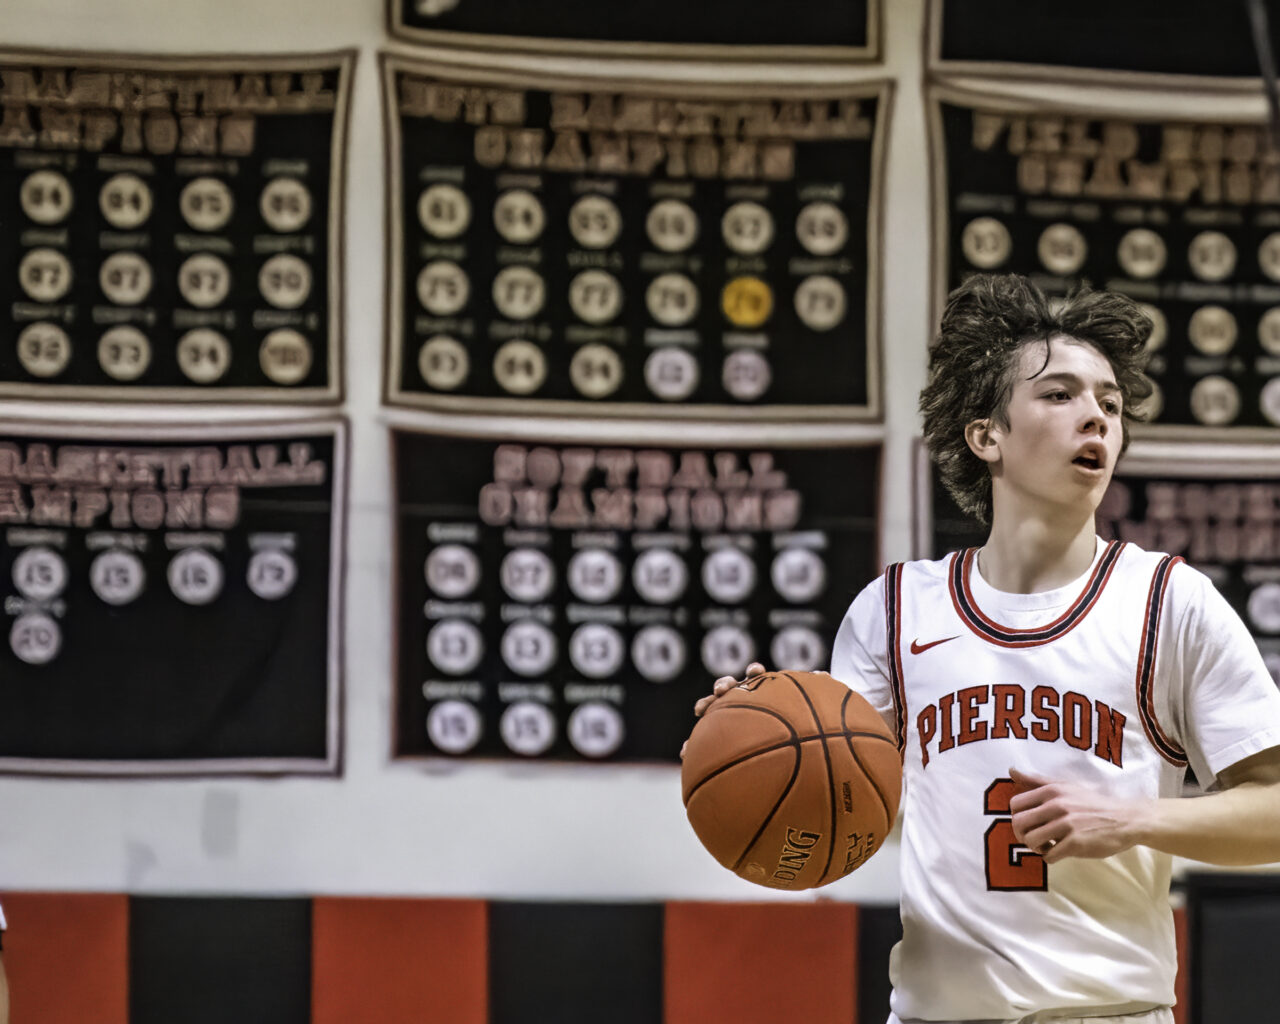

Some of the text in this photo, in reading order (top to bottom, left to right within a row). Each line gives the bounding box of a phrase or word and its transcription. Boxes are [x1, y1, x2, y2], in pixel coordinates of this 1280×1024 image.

[474, 126, 796, 181] CHAMPIONS
[493, 444, 788, 490] SOFTBALL
[479, 481, 800, 532] CHAMPIONS
[916, 683, 1127, 770] PIERSON
[983, 777, 1049, 892] 2
